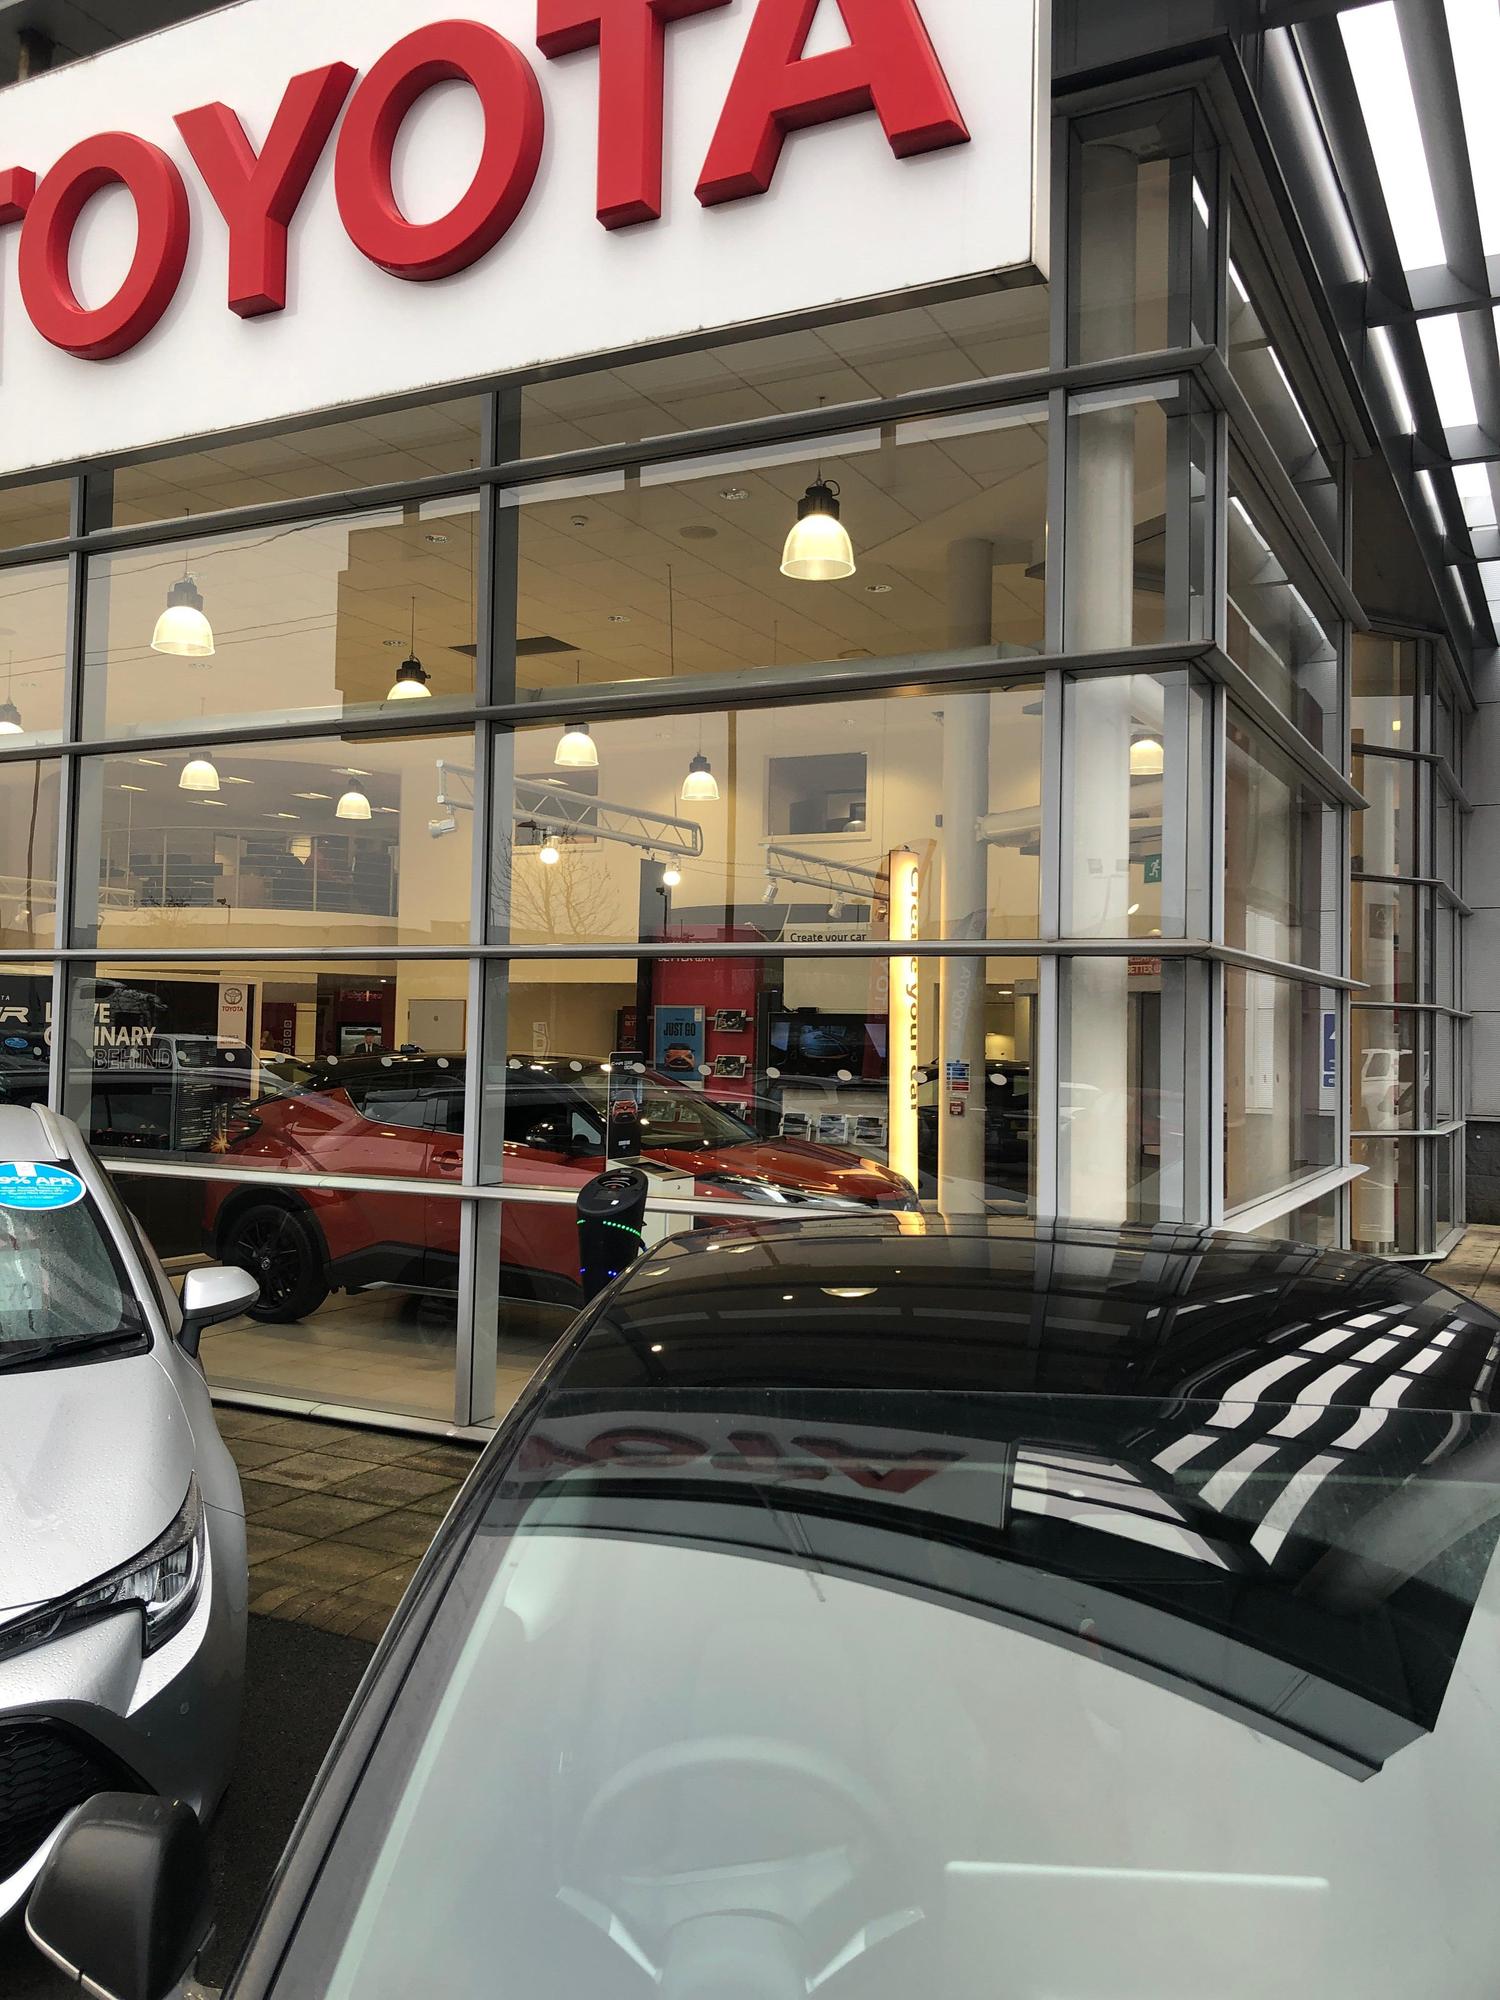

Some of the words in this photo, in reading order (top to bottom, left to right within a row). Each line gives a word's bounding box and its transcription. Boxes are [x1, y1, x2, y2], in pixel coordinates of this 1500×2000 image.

[0, 0, 970, 360] OYOTA
[790, 932, 823, 942] Create
[826, 934, 848, 942] your
[850, 933, 867, 941] car
[664, 1022, 683, 1036] JUST
[686, 1022, 696, 1036] GO
[94, 1049, 173, 1070] BEHIND
[36, 1176, 74, 1186] APR
